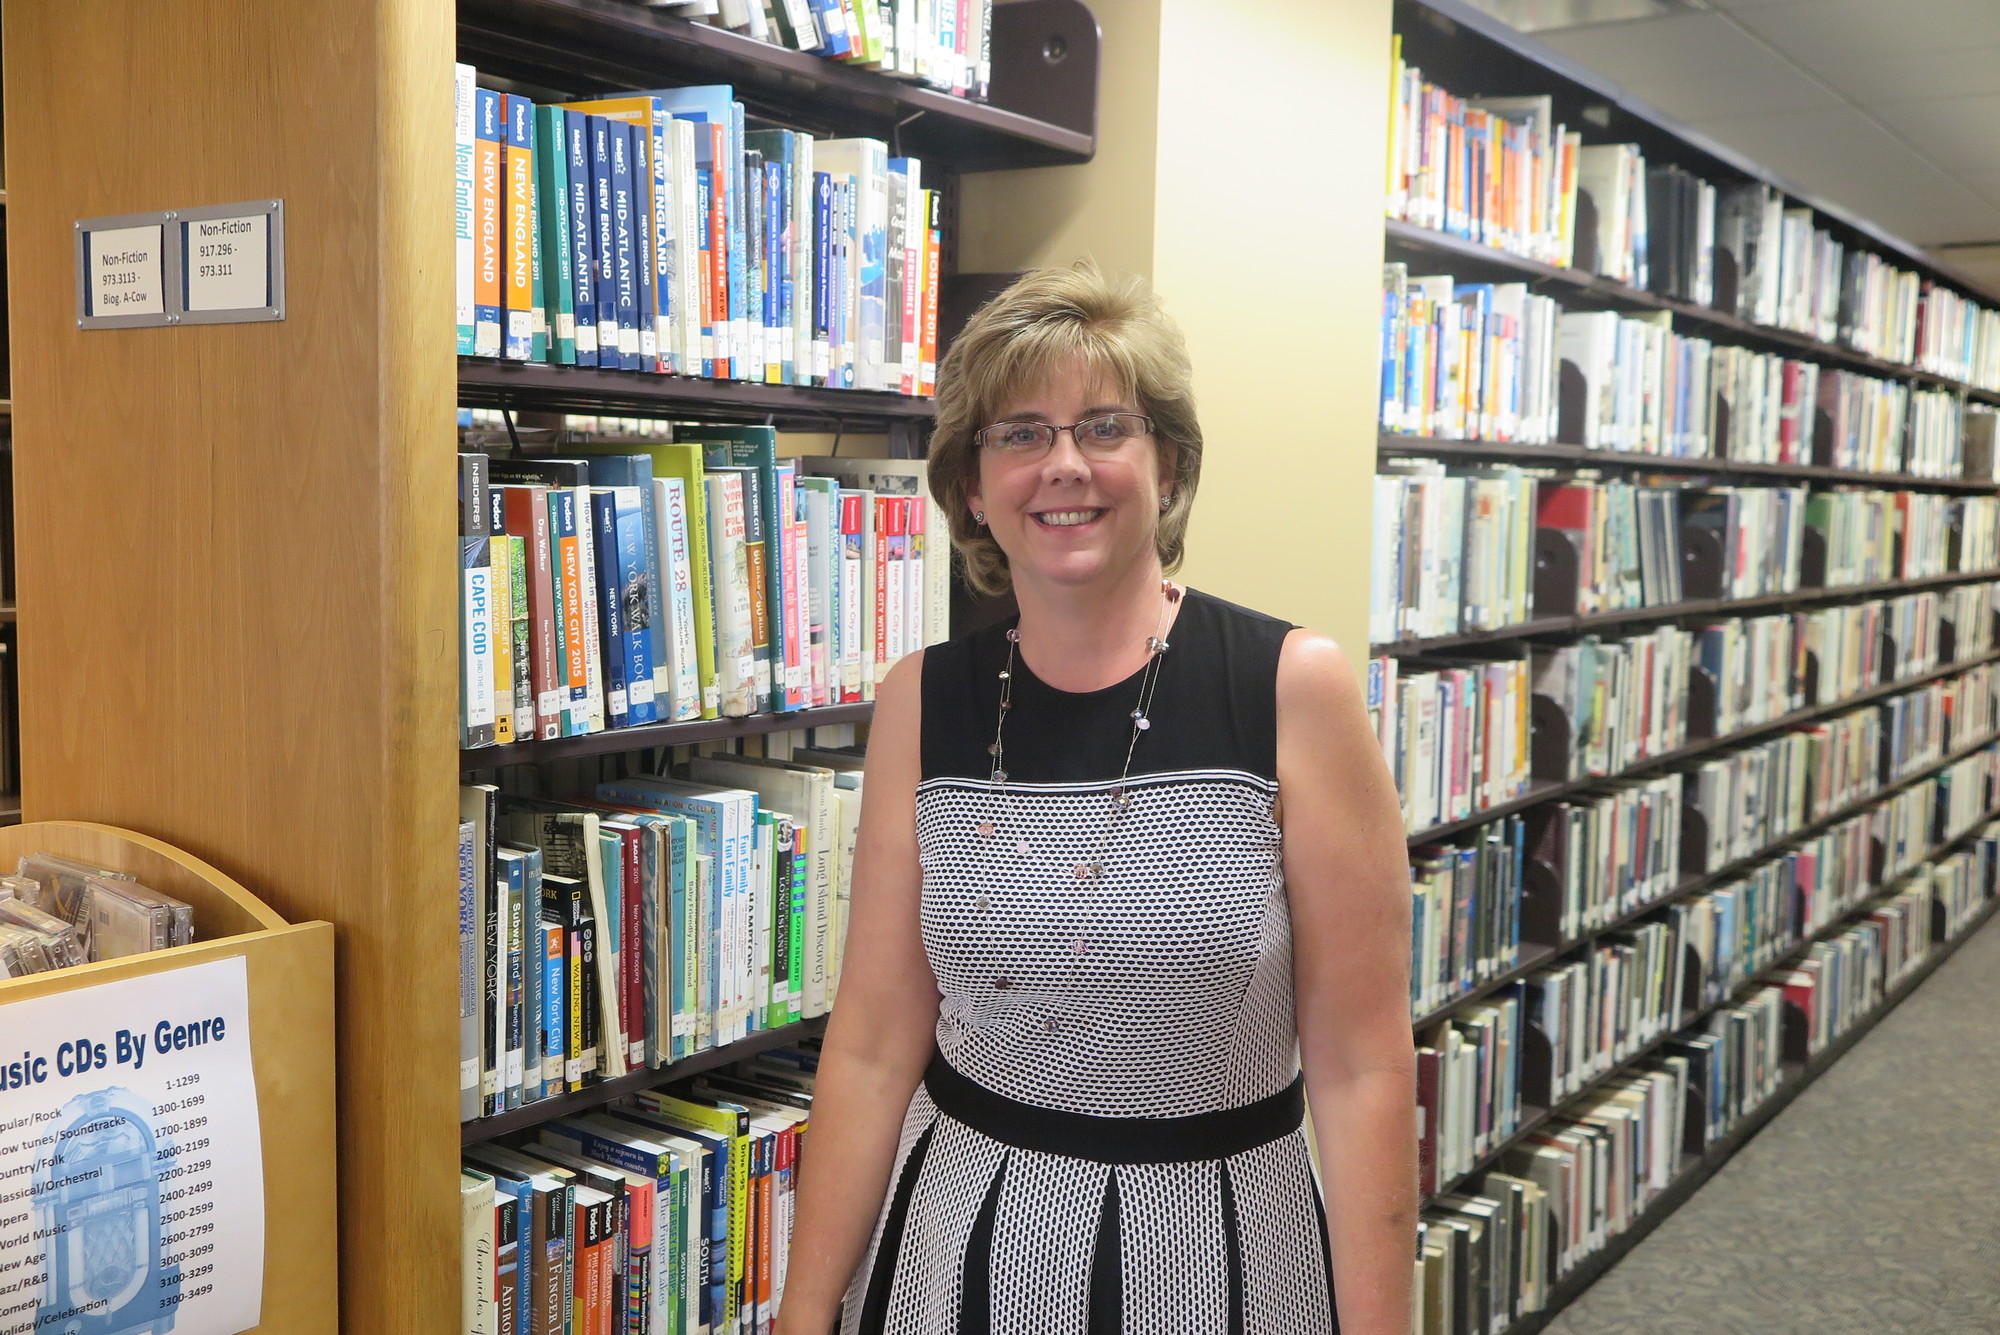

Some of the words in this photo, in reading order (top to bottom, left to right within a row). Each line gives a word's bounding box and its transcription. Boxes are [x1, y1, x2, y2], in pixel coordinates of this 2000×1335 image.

[484, 97, 494, 135] Fodor's
[516, 104, 526, 142] Fodor's
[483, 151, 495, 193] NEW
[654, 136, 663, 179] NEW
[515, 158, 527, 199] NEW
[599, 178, 607, 210] NEW
[200, 220, 252, 236] Non-Fiction
[558, 188, 568, 257] MID-ATLANTIC
[655, 184, 667, 275] ENGLAND
[200, 244, 232, 258] 917.296
[483, 197, 495, 283] ENGLAND
[515, 204, 527, 288] ENGLAND
[575, 183, 589, 302] MID-ATLANTIC
[600, 214, 611, 278] ENGLAND
[617, 190, 631, 306] MID-ATLANTIC
[102, 250, 148, 266] Non-Fiction
[200, 264, 232, 278] 973.311
[102, 272, 136, 286] 973.3113
[718, 276, 725, 286] IN
[906, 250, 915, 315] BERKSHIRES
[928, 251, 938, 310] BOSTON
[103, 292, 121, 306] Biog.
[124, 290, 147, 304] A-Cow
[927, 313, 936, 344] 2012
[472, 462, 481, 526] INSIDERS'
[493, 494, 501, 530] Fodor's
[536, 518, 545, 537] Day
[564, 497, 572, 531] Fodor's
[670, 485, 684, 562] ROUTE
[585, 528, 592, 539] to
[625, 522, 636, 555] NEW
[491, 545, 499, 588] MARTHA'S
[565, 546, 576, 577] NEW
[471, 574, 486, 616] CAPE
[589, 587, 596, 596] in
[628, 561, 639, 605] YORK
[674, 570, 686, 592] 28
[492, 590, 501, 634] VINEYARD
[567, 580, 579, 615] YORK
[472, 622, 487, 654] COD
[570, 619, 580, 646] CITY
[589, 600, 599, 655] Manhattan
[631, 608, 642, 650] WALK
[571, 650, 582, 677] 2015
[724, 838, 735, 857] Fun
[739, 835, 749, 855] Fun
[723, 860, 735, 898] Family
[739, 858, 749, 894] Family
[815, 850, 829, 880] Long
[816, 884, 828, 921] Island
[486, 913, 497, 946] NEW
[511, 903, 522, 977] Subwayland
[813, 924, 828, 984] Discovery
[486, 954, 497, 999] YORK
[551, 968, 560, 994] New
[550, 998, 560, 1023] York
[56, 1038, 107, 1077] CDs
[115, 1029, 146, 1069] By
[154, 1016, 225, 1054] Genre
[550, 1026, 559, 1050] City
[166, 1073, 200, 1090] 1-1299
[152, 1094, 205, 1116] 1300-1699
[22, 1116, 126, 1150] tunes/Soundtracks
[155, 1116, 208, 1138] 1700-1899
[157, 1137, 210, 1160] 2000-2199
[159, 1159, 211, 1182] 2200-2299
[160, 1180, 212, 1204] 2400-2499
[658, 1193, 670, 1217] The
[160, 1202, 214, 1225] 2500-2599
[589, 1208, 598, 1240] Fodor's
[33, 1224, 67, 1241] Music
[161, 1222, 214, 1246] 2600-2799
[655, 1223, 669, 1265] Finger
[24, 1253, 46, 1266] Age
[161, 1244, 214, 1268] 3000-3099
[700, 1238, 710, 1286] SOUTH
[160, 1264, 214, 1288] 3100-3299
[548, 1262, 562, 1322] FINGER
[658, 1270, 668, 1306] Lakes
[0, 1298, 42, 1317] omedy
[160, 1284, 213, 1309] 3300-3499
